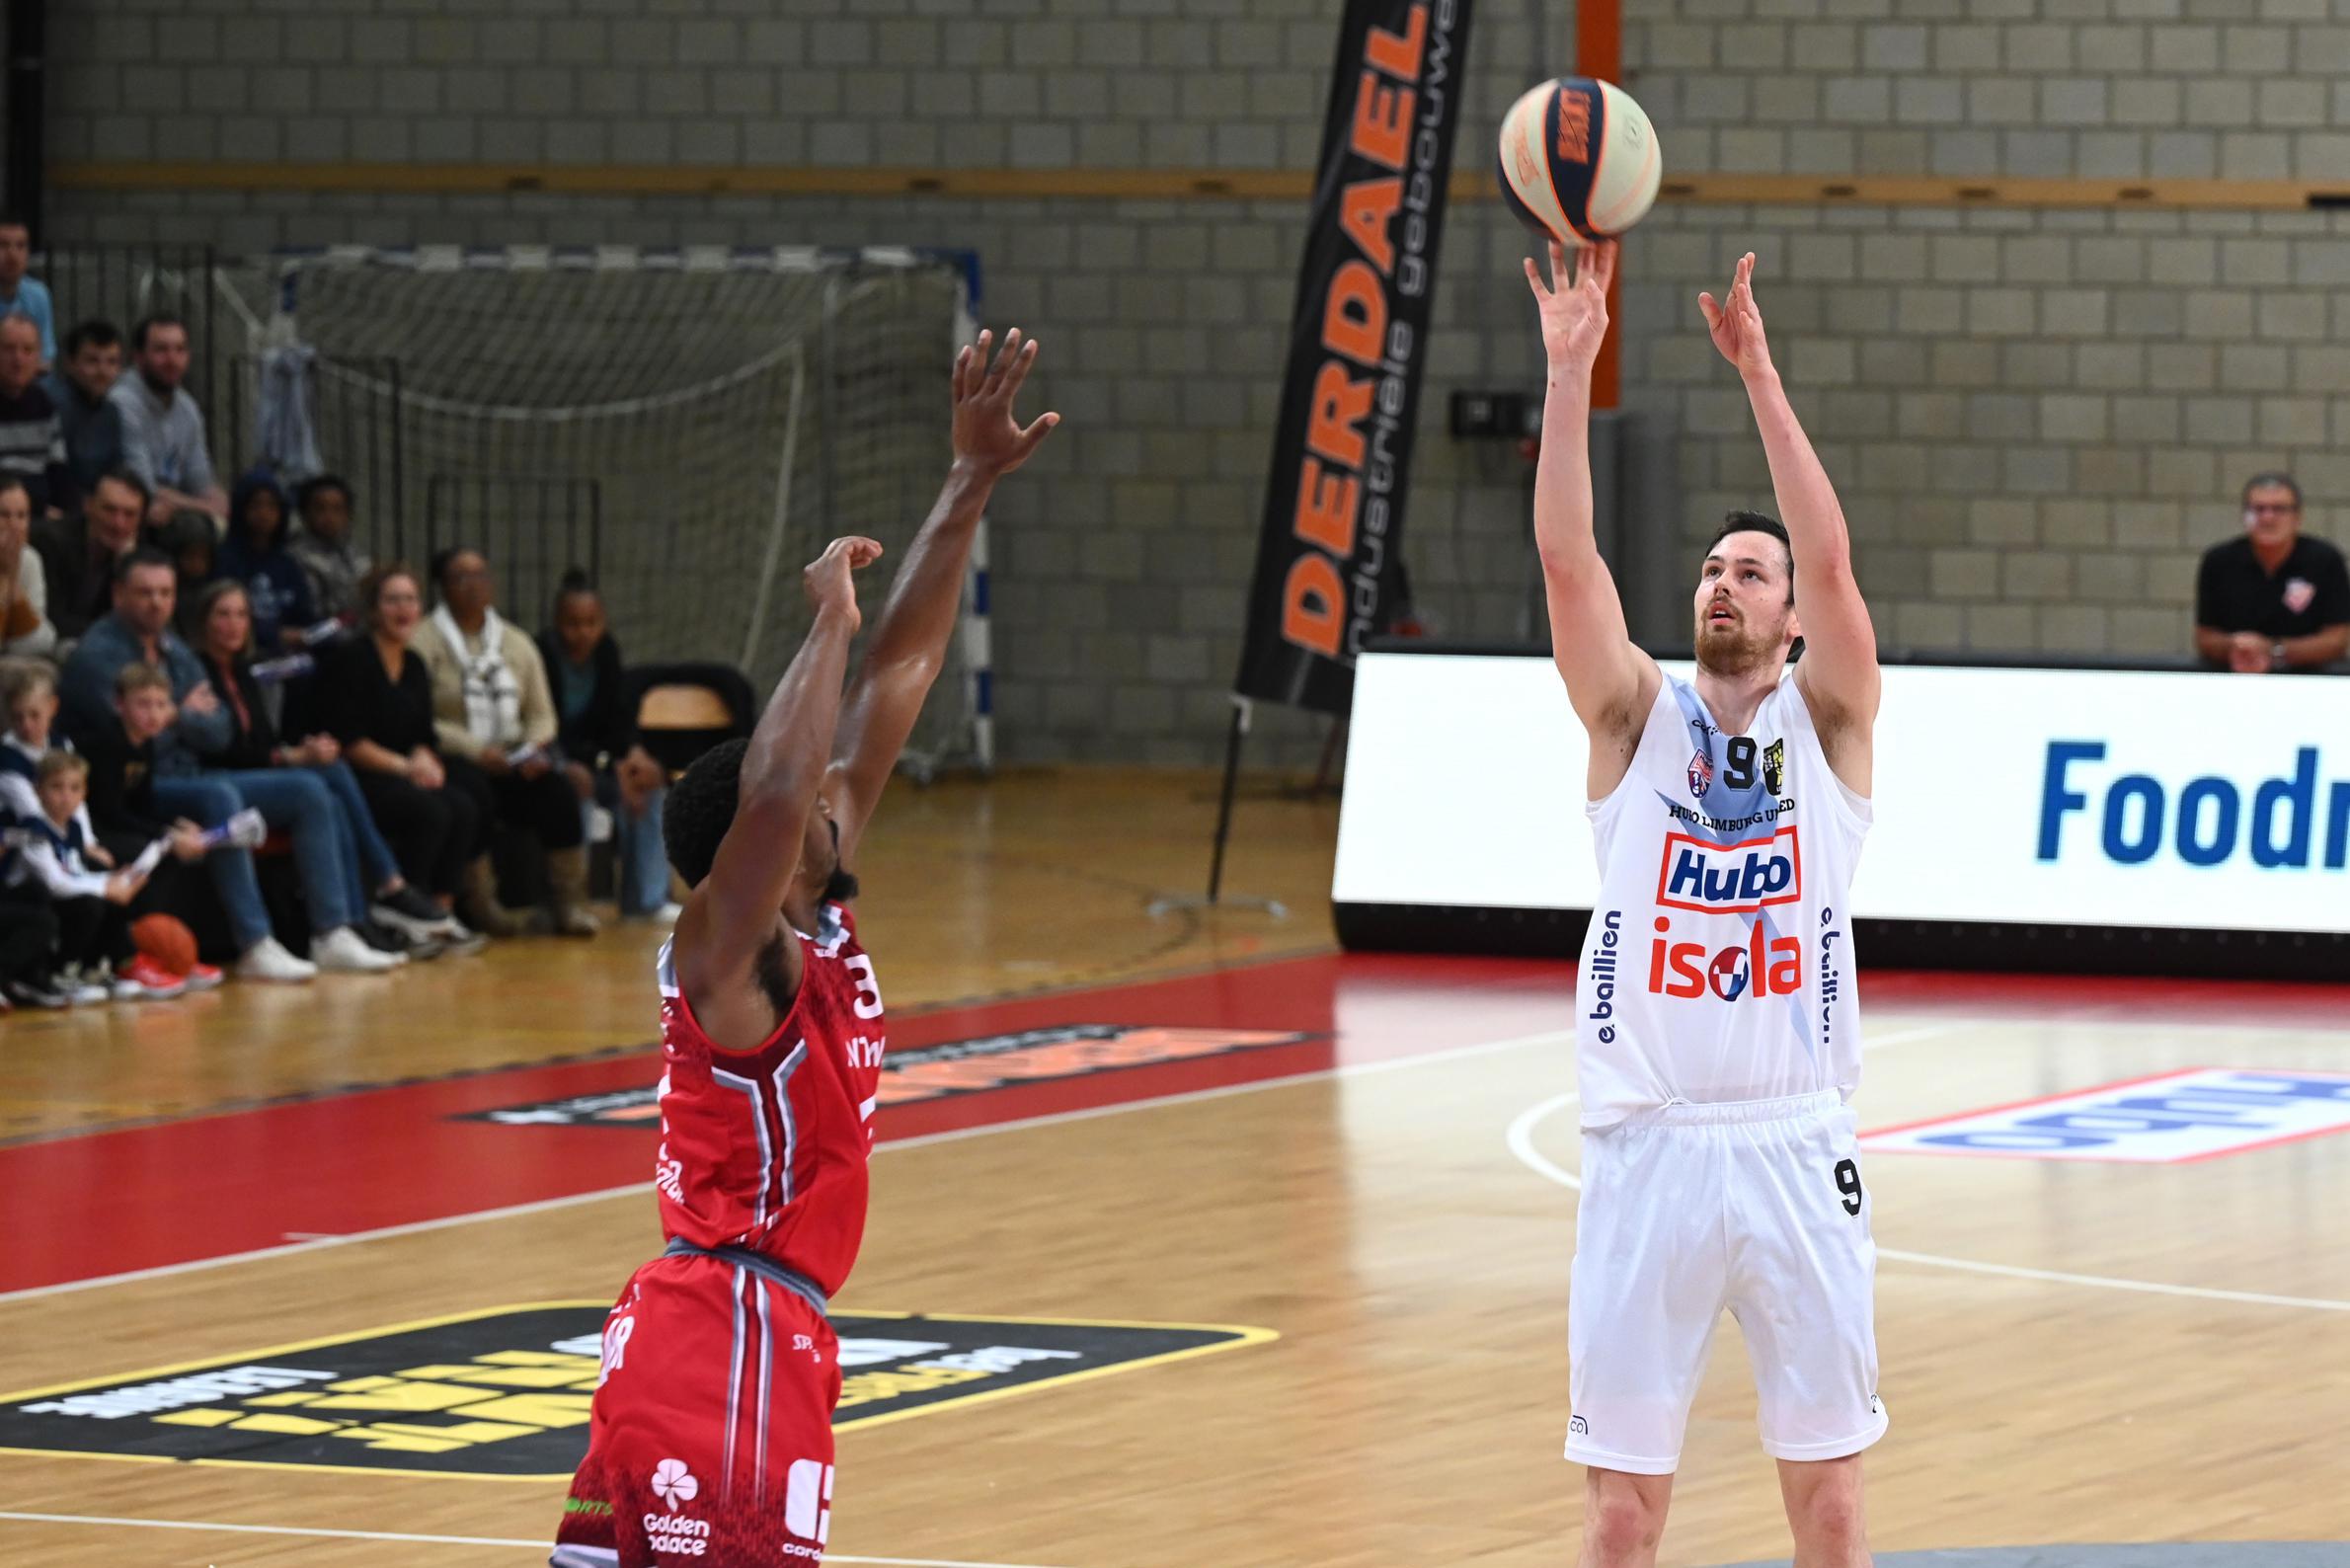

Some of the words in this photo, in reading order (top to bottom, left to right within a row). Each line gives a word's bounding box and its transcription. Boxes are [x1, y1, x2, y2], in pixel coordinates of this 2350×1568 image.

[1281, 3, 1429, 660] DERDAEL
[1723, 737, 1757, 790] 9
[1702, 812, 1763, 832] LIMBURG
[1668, 849, 1791, 902] Hubo
[1649, 915, 1802, 1002] isola
[1834, 1158, 1862, 1216] 9
[643, 1513, 710, 1537] Golden
